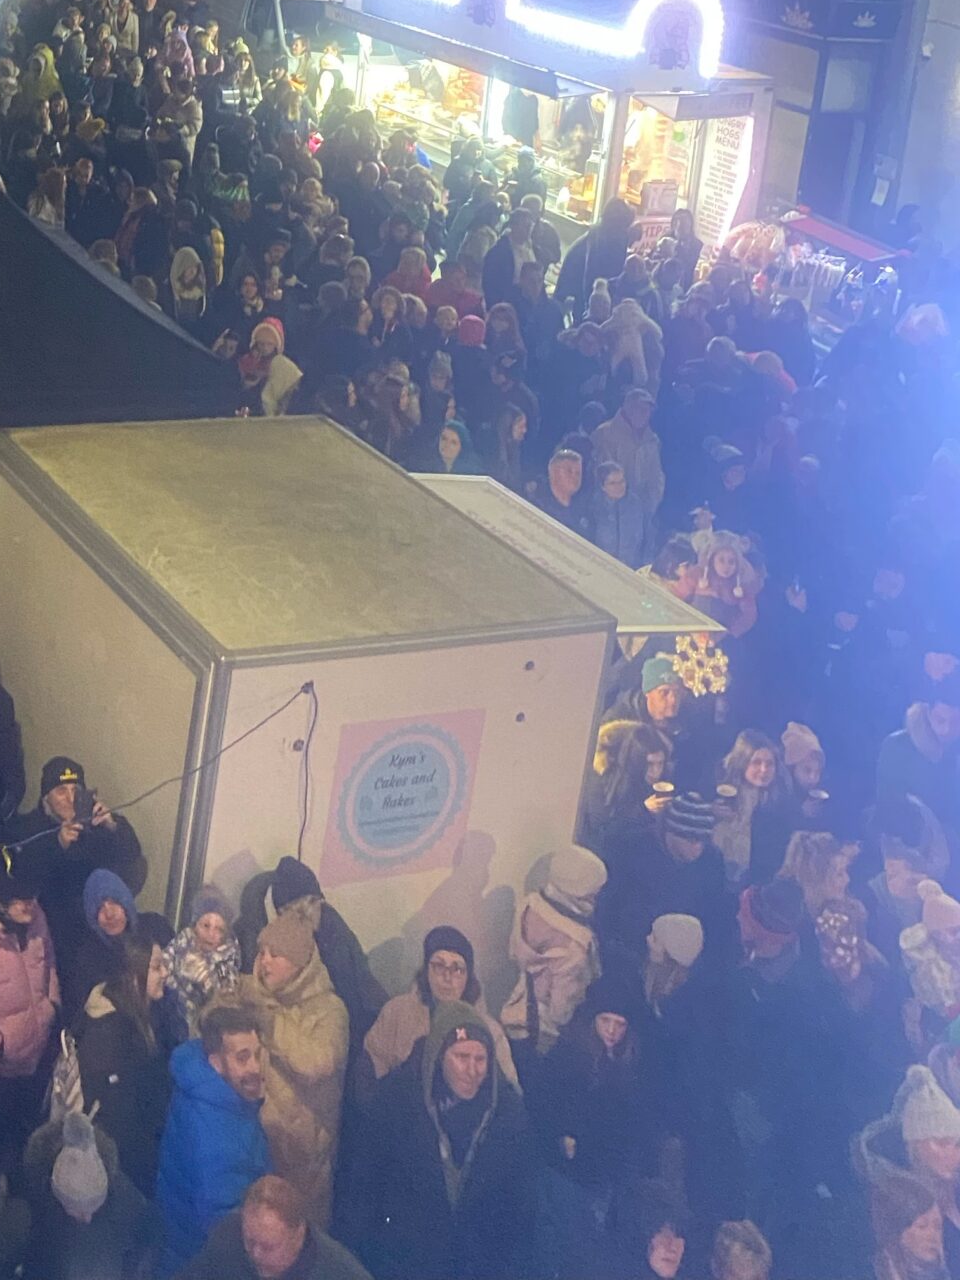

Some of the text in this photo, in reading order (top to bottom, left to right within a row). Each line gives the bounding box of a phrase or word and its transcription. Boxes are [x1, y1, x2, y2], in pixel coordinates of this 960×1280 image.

[716, 125, 740, 140] HOGS
[715, 135, 740, 150] MENU
[388, 752, 426, 770] Kym's
[374, 768, 437, 790] Cakes and
